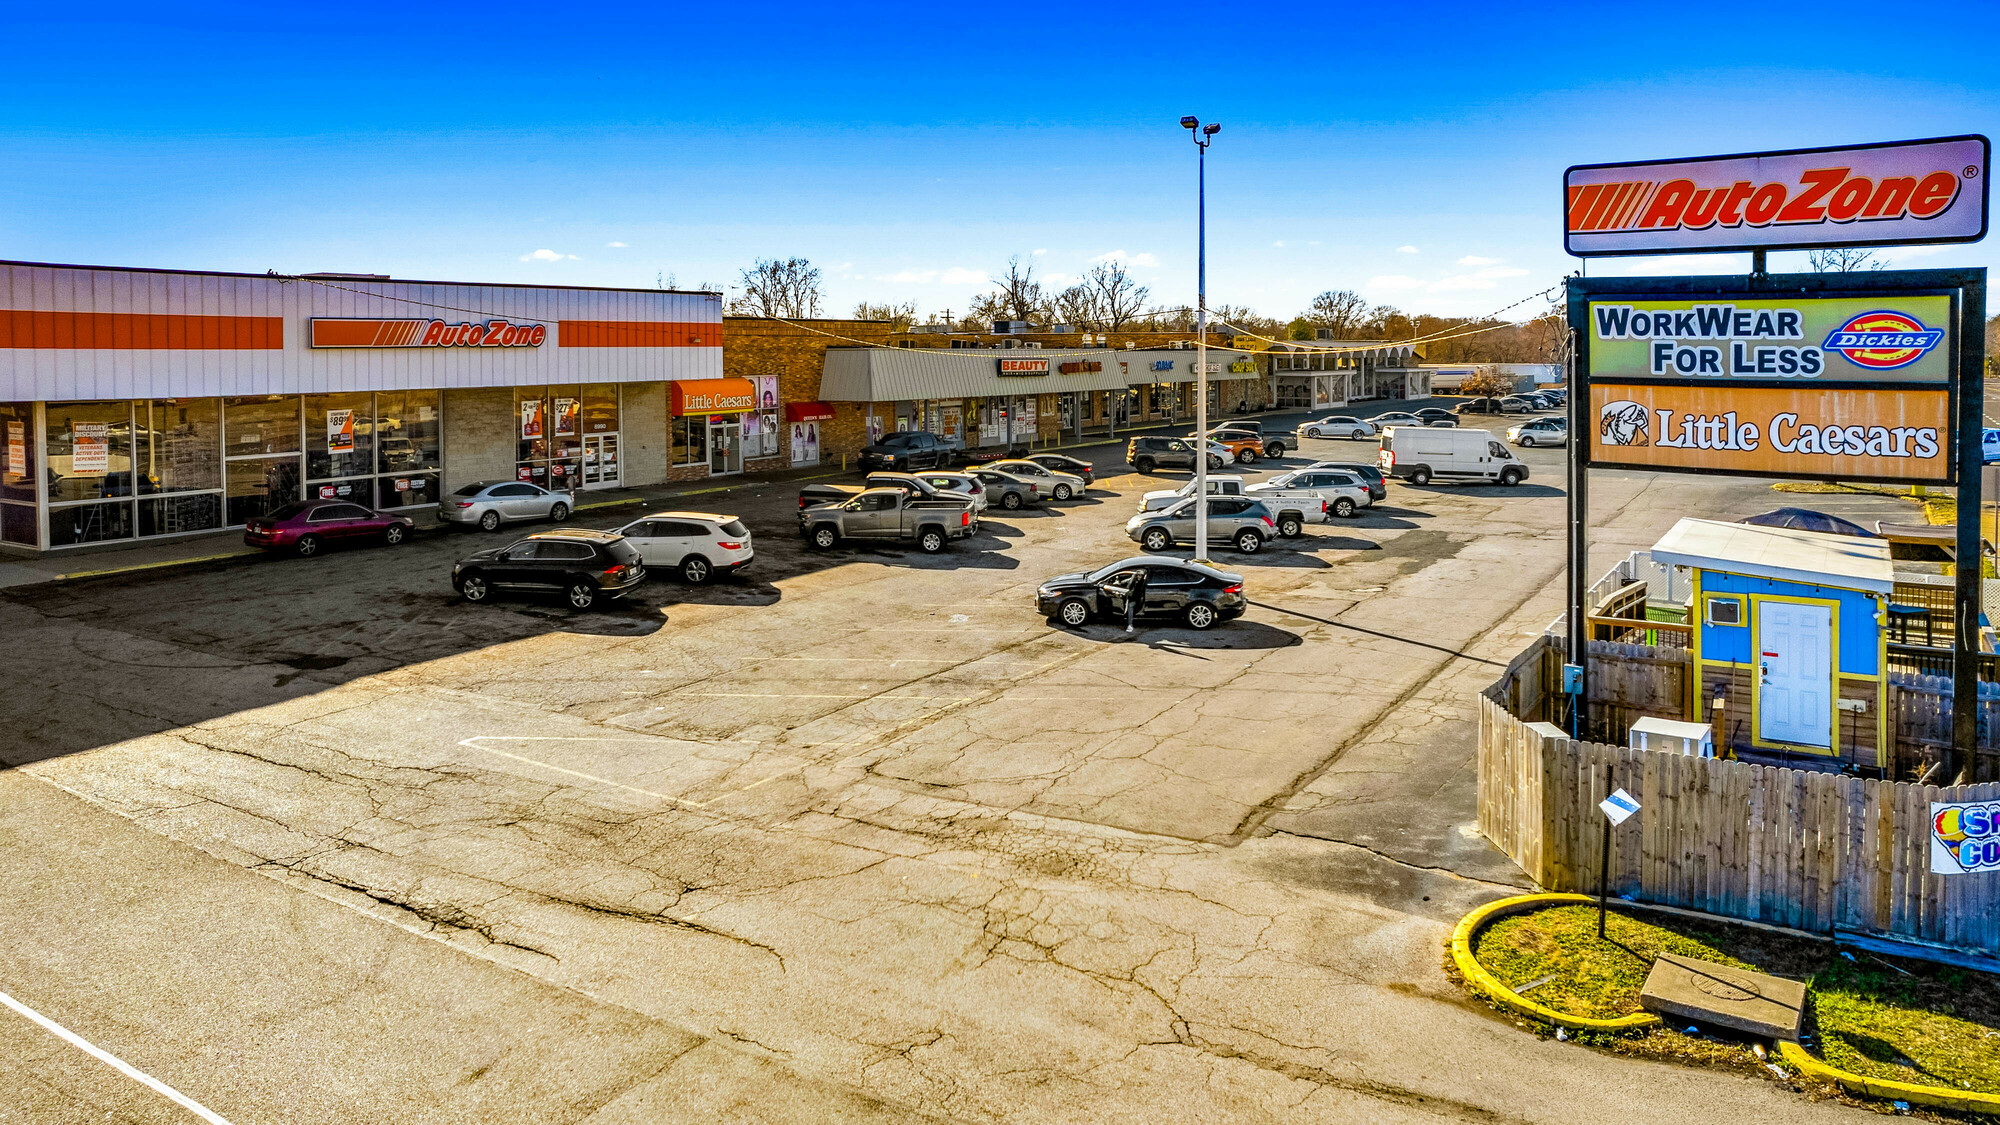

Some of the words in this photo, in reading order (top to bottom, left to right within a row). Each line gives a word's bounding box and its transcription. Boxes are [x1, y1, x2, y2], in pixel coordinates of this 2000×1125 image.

[1637, 167, 1961, 229] AutoZone
[422, 320, 546, 347] AutoZone
[1836, 333, 1930, 348] Dickies
[1002, 361, 1047, 370] BEAUTY
[685, 394, 712, 410] Little
[714, 393, 752, 408] Caesars
[1655, 410, 1760, 452] Little
[1768, 413, 1940, 459] Caesars
[321, 488, 334, 496] FREE
